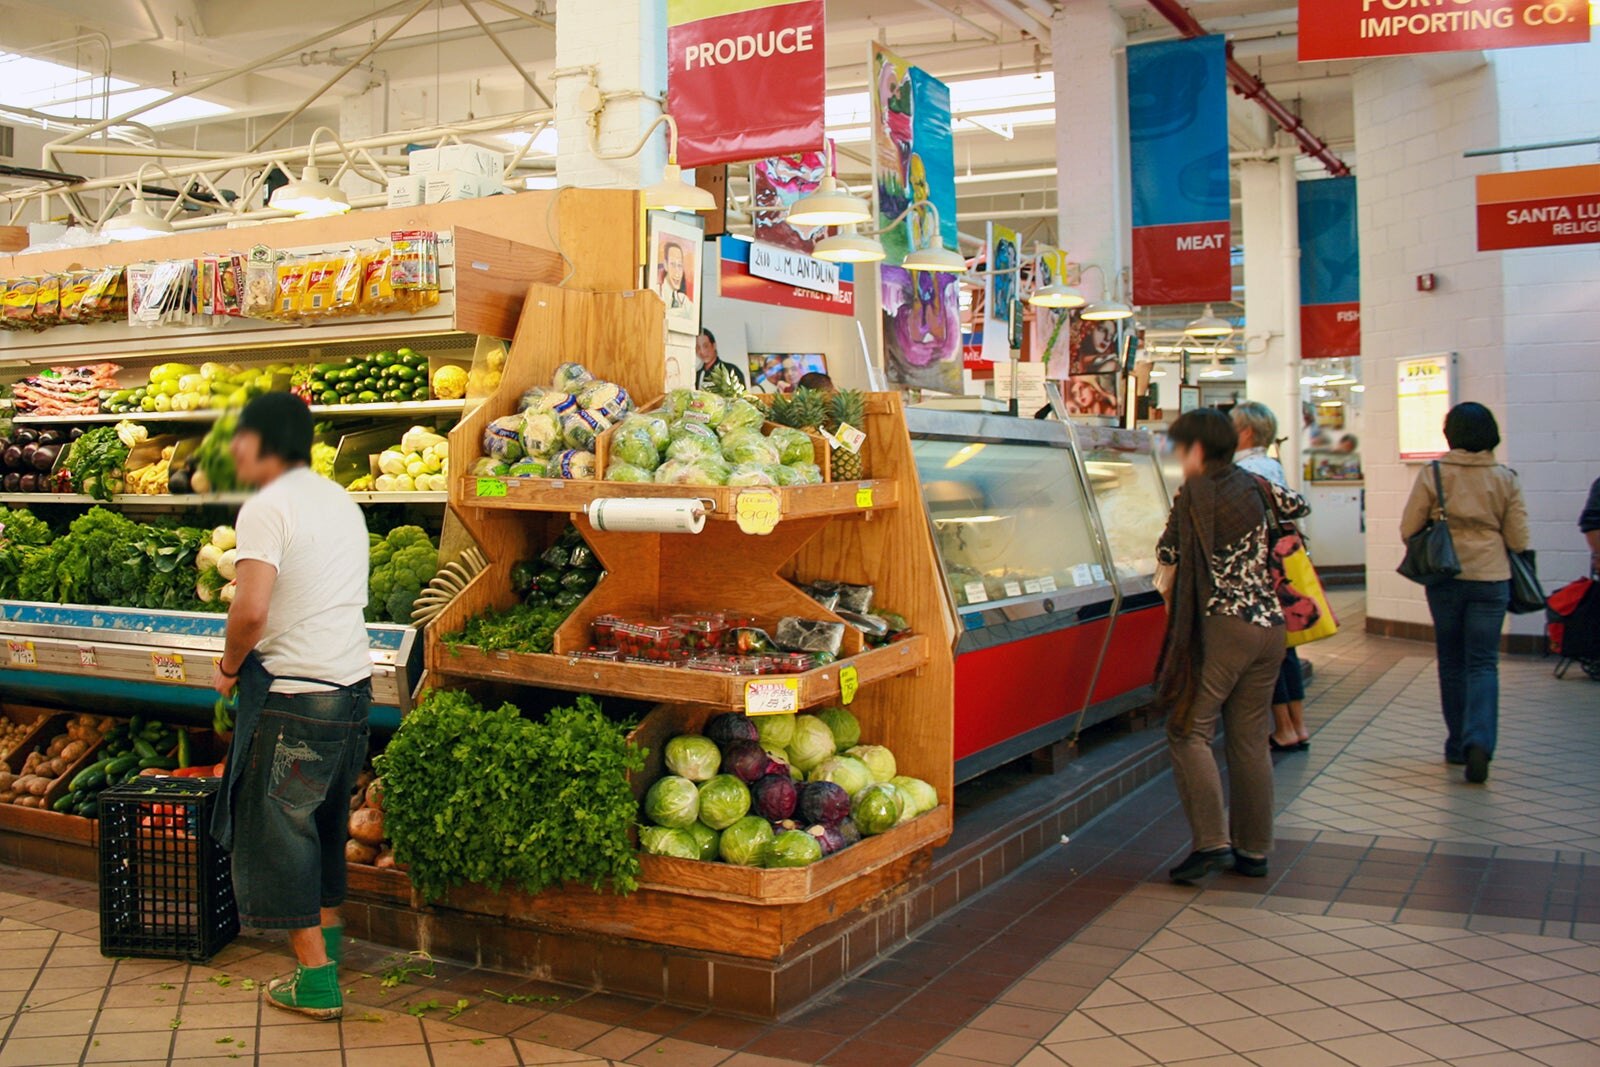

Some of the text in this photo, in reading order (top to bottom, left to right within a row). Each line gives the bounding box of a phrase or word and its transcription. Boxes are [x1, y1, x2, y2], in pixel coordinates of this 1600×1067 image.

[1359, 7, 1514, 39] IMPORTING
[1523, 4, 1576, 26] CO.
[685, 25, 814, 71] PRODUCE
[1506, 205, 1572, 225] SANTA
[1176, 234, 1225, 251] MEAT
[793, 287, 831, 301] JEFFREYS
